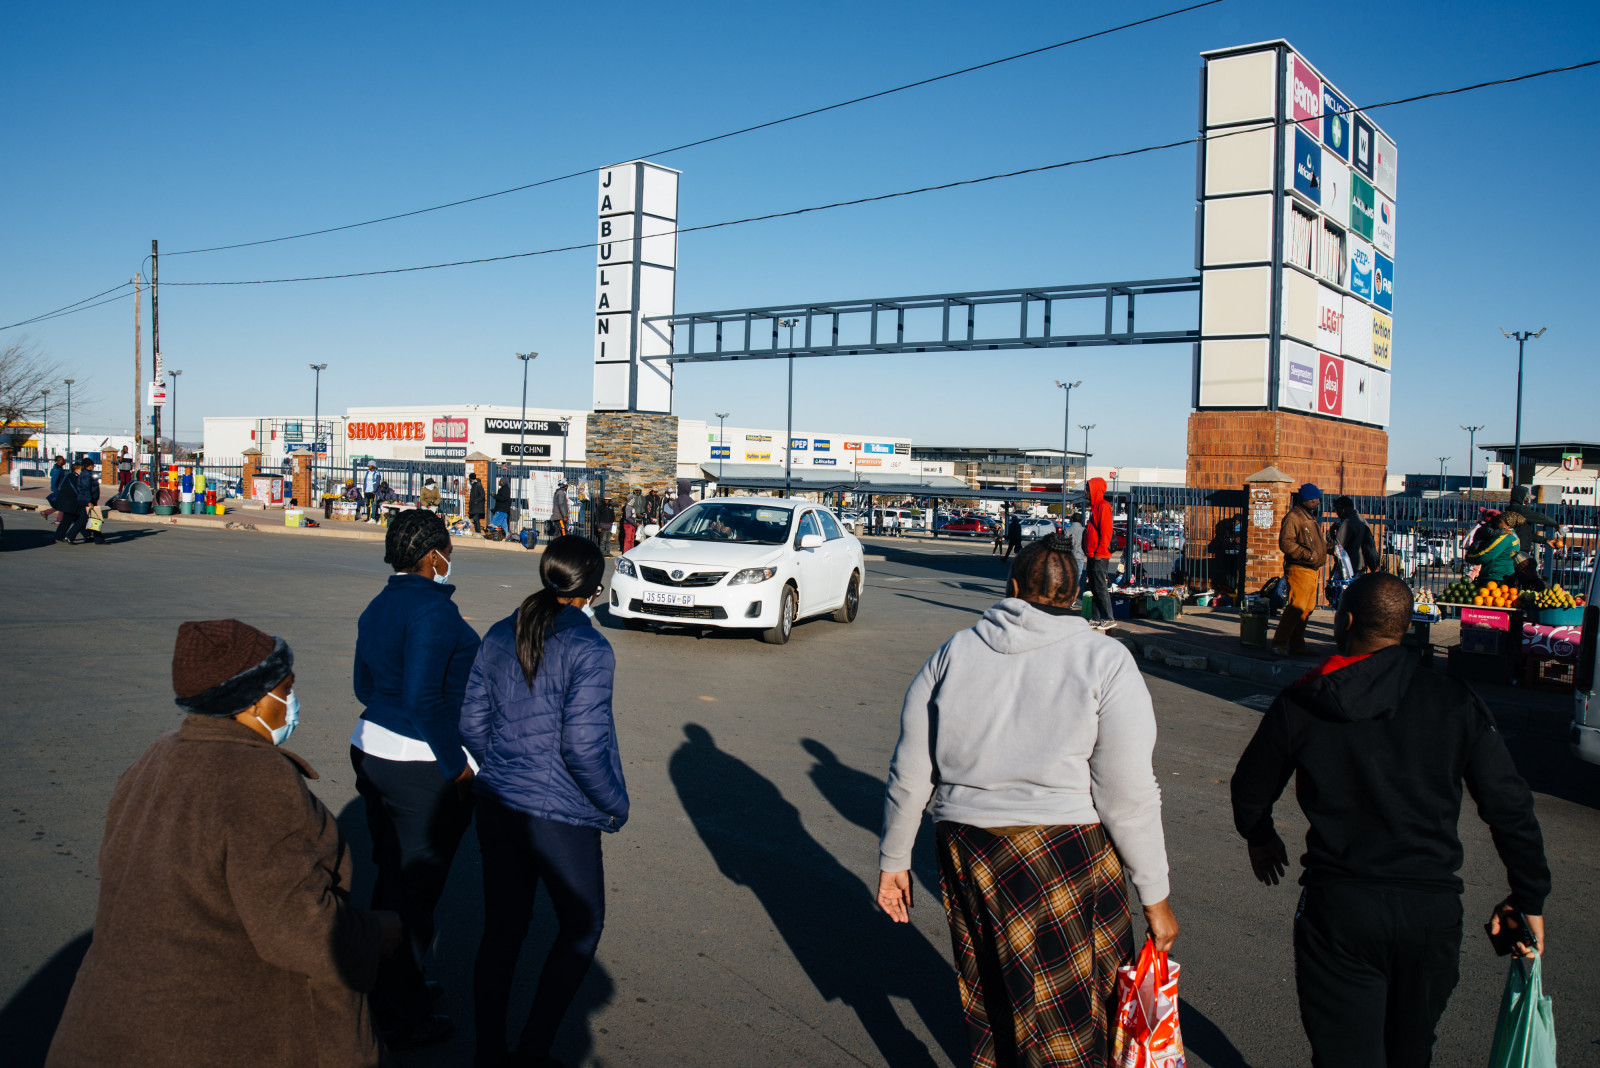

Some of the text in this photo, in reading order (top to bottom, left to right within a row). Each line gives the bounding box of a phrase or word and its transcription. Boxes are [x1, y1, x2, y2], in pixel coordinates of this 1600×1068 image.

[1294, 77, 1319, 120] game
[598, 171, 612, 358] JABULANI
[347, 421, 426, 440] SHOPRITE
[433, 421, 466, 438] game
[487, 419, 549, 431] WOOLWORTHS
[510, 445, 544, 454] FOCHINI
[794, 440, 807, 449] PEP
[646, 592, 655, 602] JS
[656, 593, 666, 603] 55
[682, 595, 691, 605] GP
